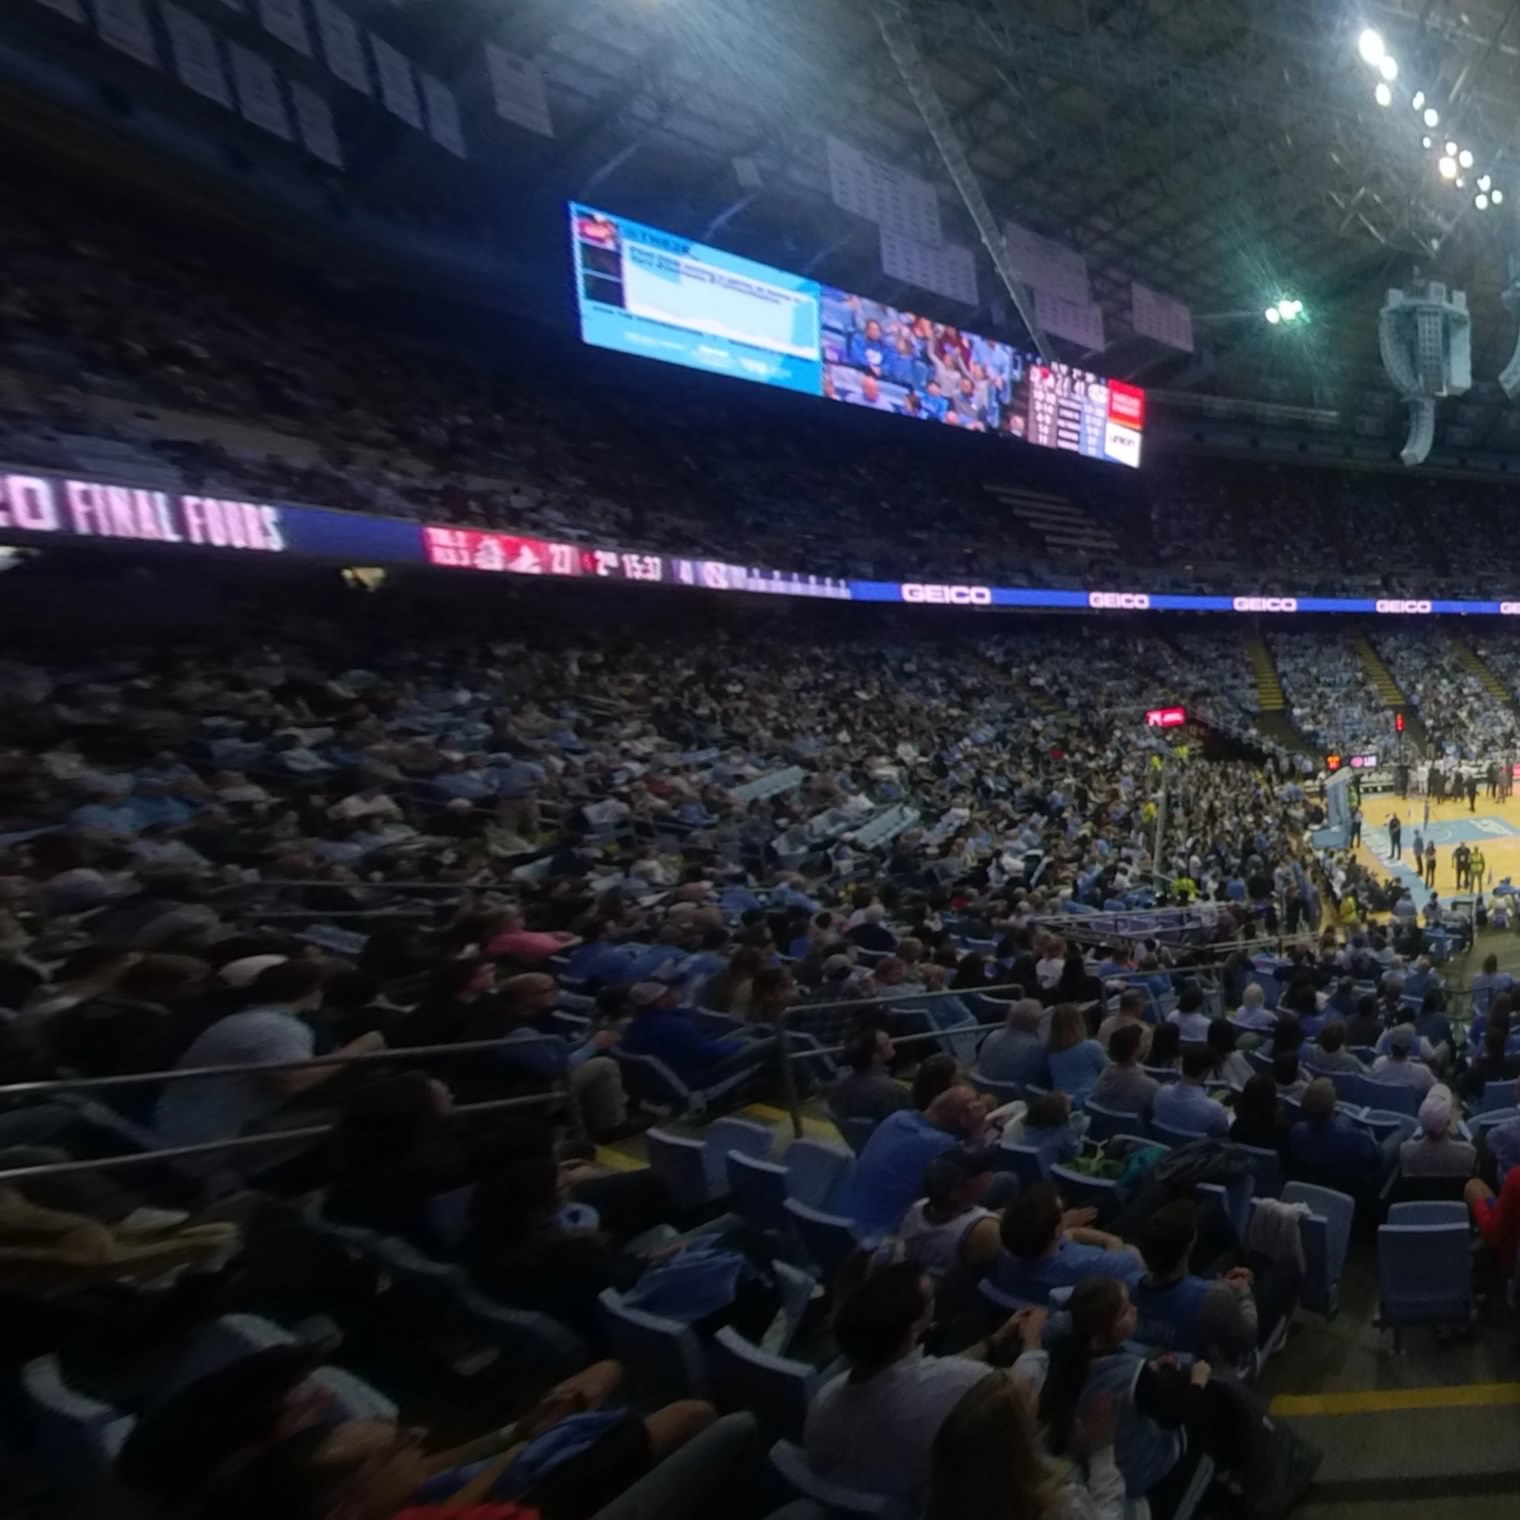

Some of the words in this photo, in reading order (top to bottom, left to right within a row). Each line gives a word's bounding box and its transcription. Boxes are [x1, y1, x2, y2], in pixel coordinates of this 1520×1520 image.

[0, 473, 60, 531] 0
[65, 480, 183, 542] FINAL
[181, 495, 286, 552] FOURS
[621, 553, 661, 581] 15:37
[901, 583, 991, 604] GEICO
[1089, 592, 1149, 609] GEICO
[1233, 597, 1297, 612] GEICO
[1376, 599, 1431, 613] GEICO
